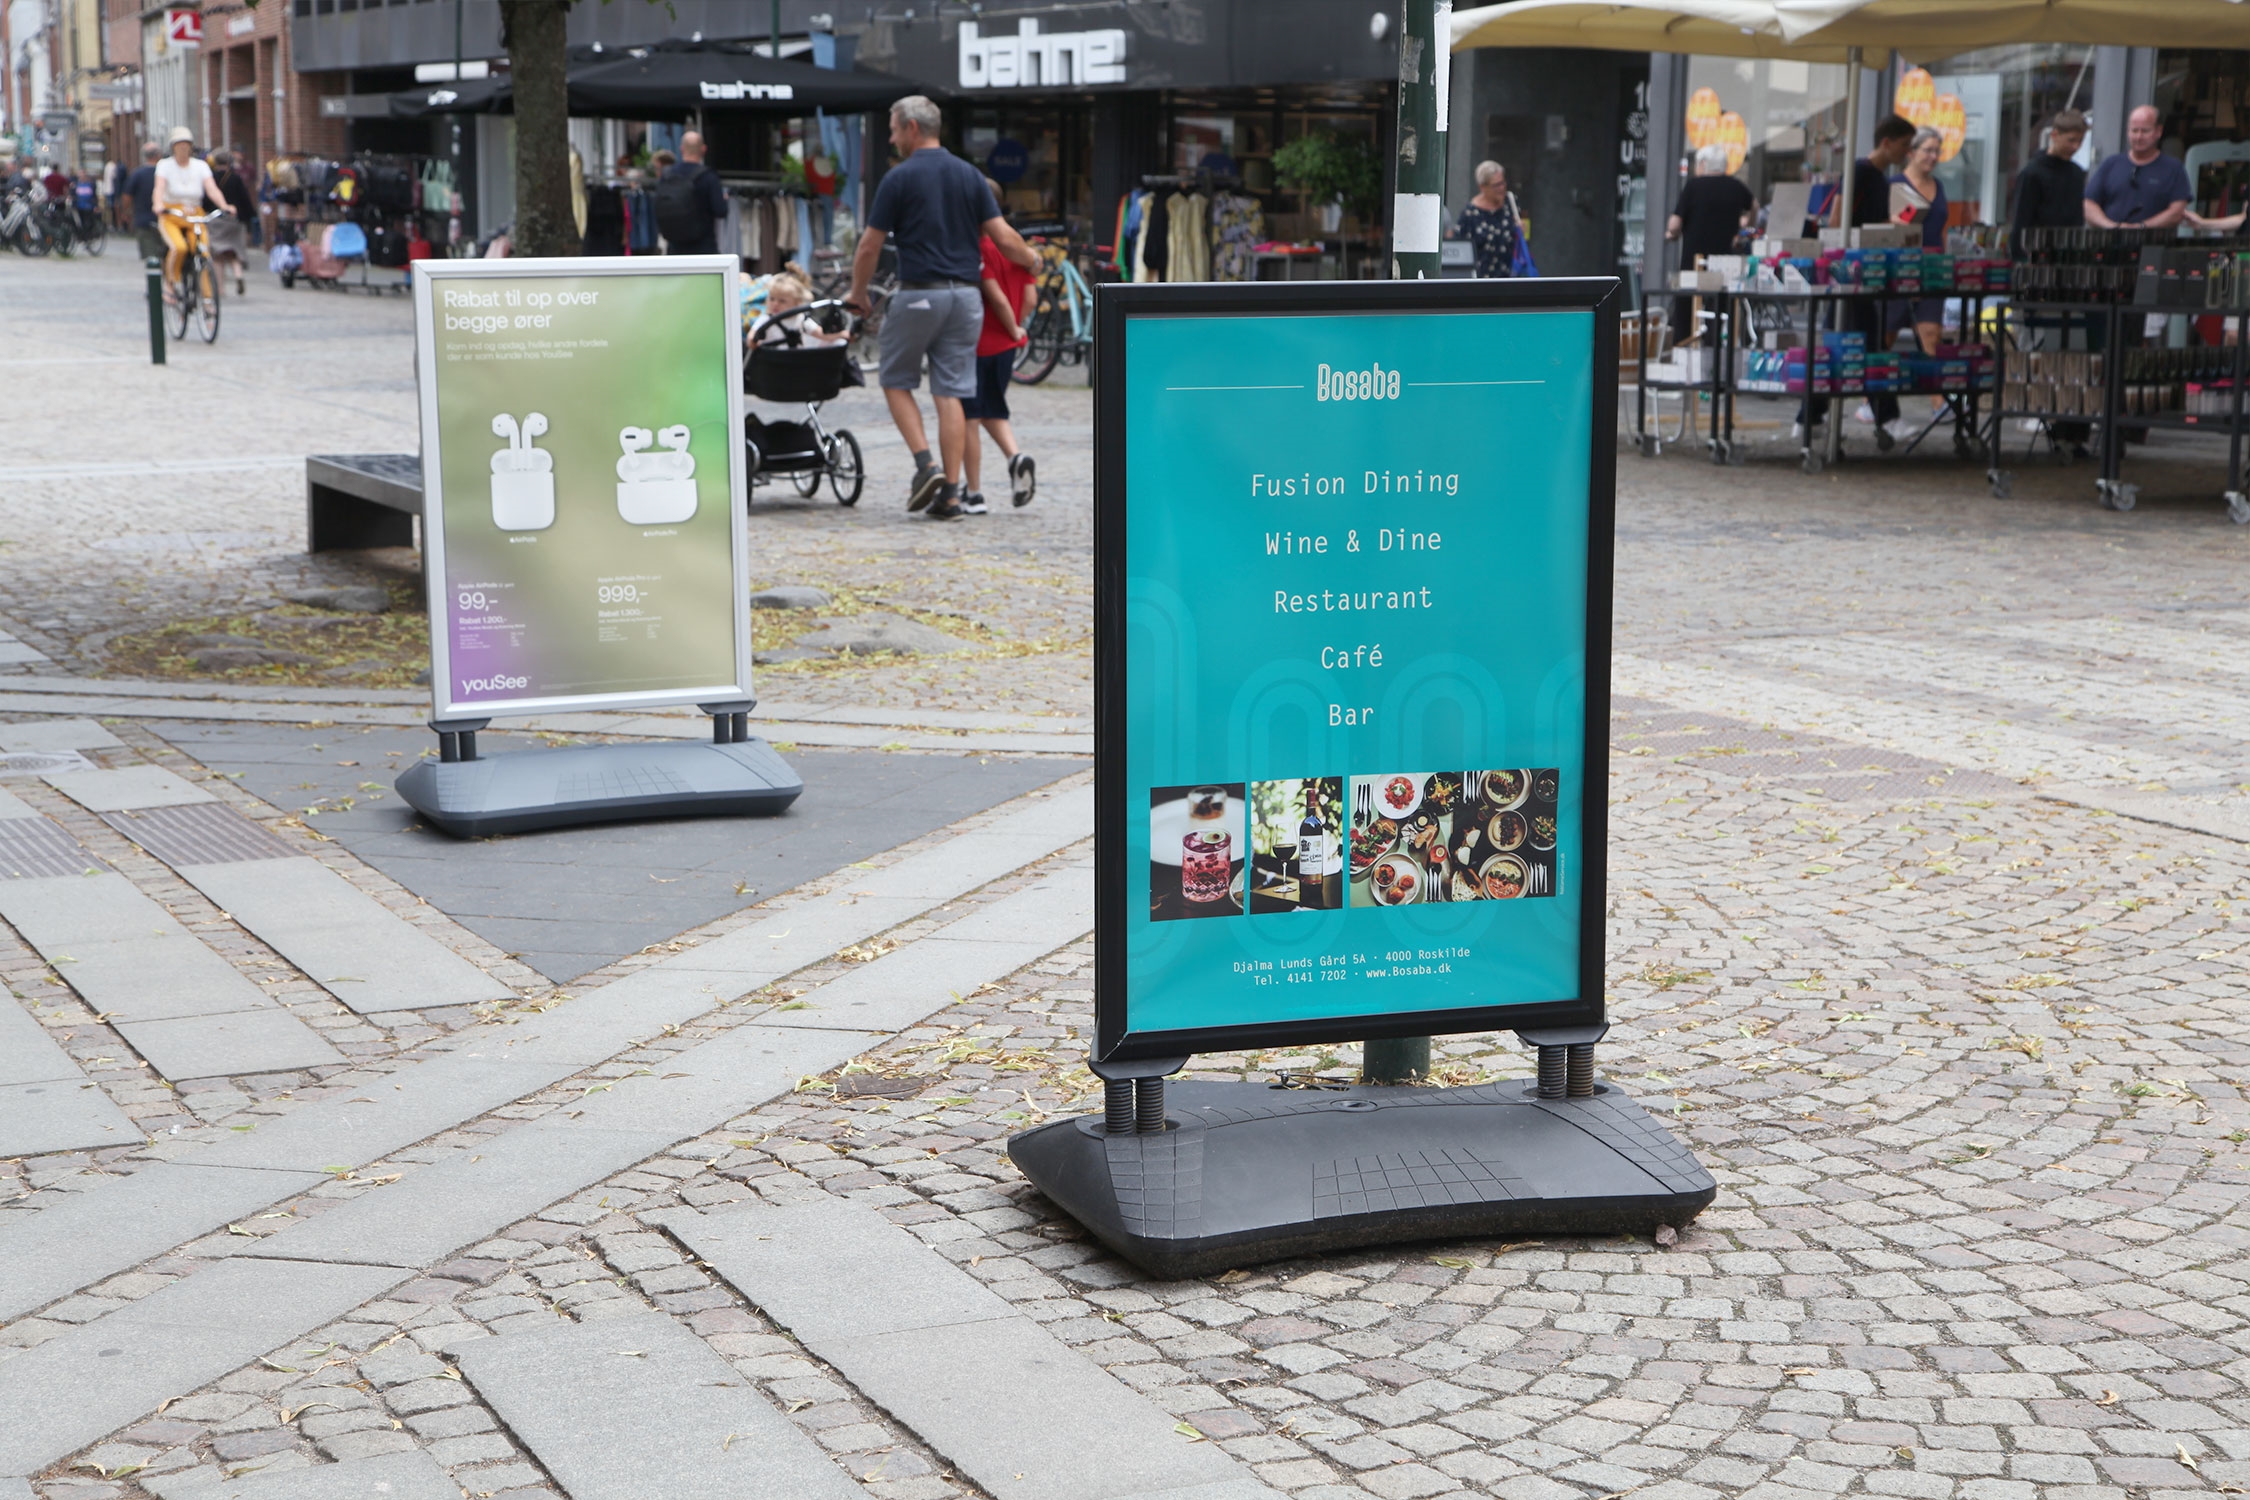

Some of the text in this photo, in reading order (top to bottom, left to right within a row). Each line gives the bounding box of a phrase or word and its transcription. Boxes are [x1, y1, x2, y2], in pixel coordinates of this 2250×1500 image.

[958, 17, 1128, 90] bahne
[699, 79, 795, 101] bahne
[444, 289, 599, 310] Rabat til op over
[445, 313, 553, 334] begge ører
[447, 352, 461, 361] der
[495, 350, 522, 360] kunde
[524, 350, 540, 359] hos
[469, 341, 482, 350] ind
[484, 342, 495, 352] og
[1317, 362, 1401, 401] Bosaba
[1251, 469, 1459, 497] Fusion Dining
[1265, 528, 1442, 555] Wine & Dine
[459, 591, 498, 612] 99,-
[598, 584, 649, 604] 999,-
[1274, 586, 1433, 613] Restaurant
[1321, 643, 1383, 670] Café
[462, 674, 528, 695] youSee
[1329, 703, 1374, 727] Bar
[1233, 947, 1471, 973] Djalma Lunds Gård 5A 4000 Roskilde
[1254, 962, 1452, 986] Tel. 4141 7202 www.Bosaba.dk
